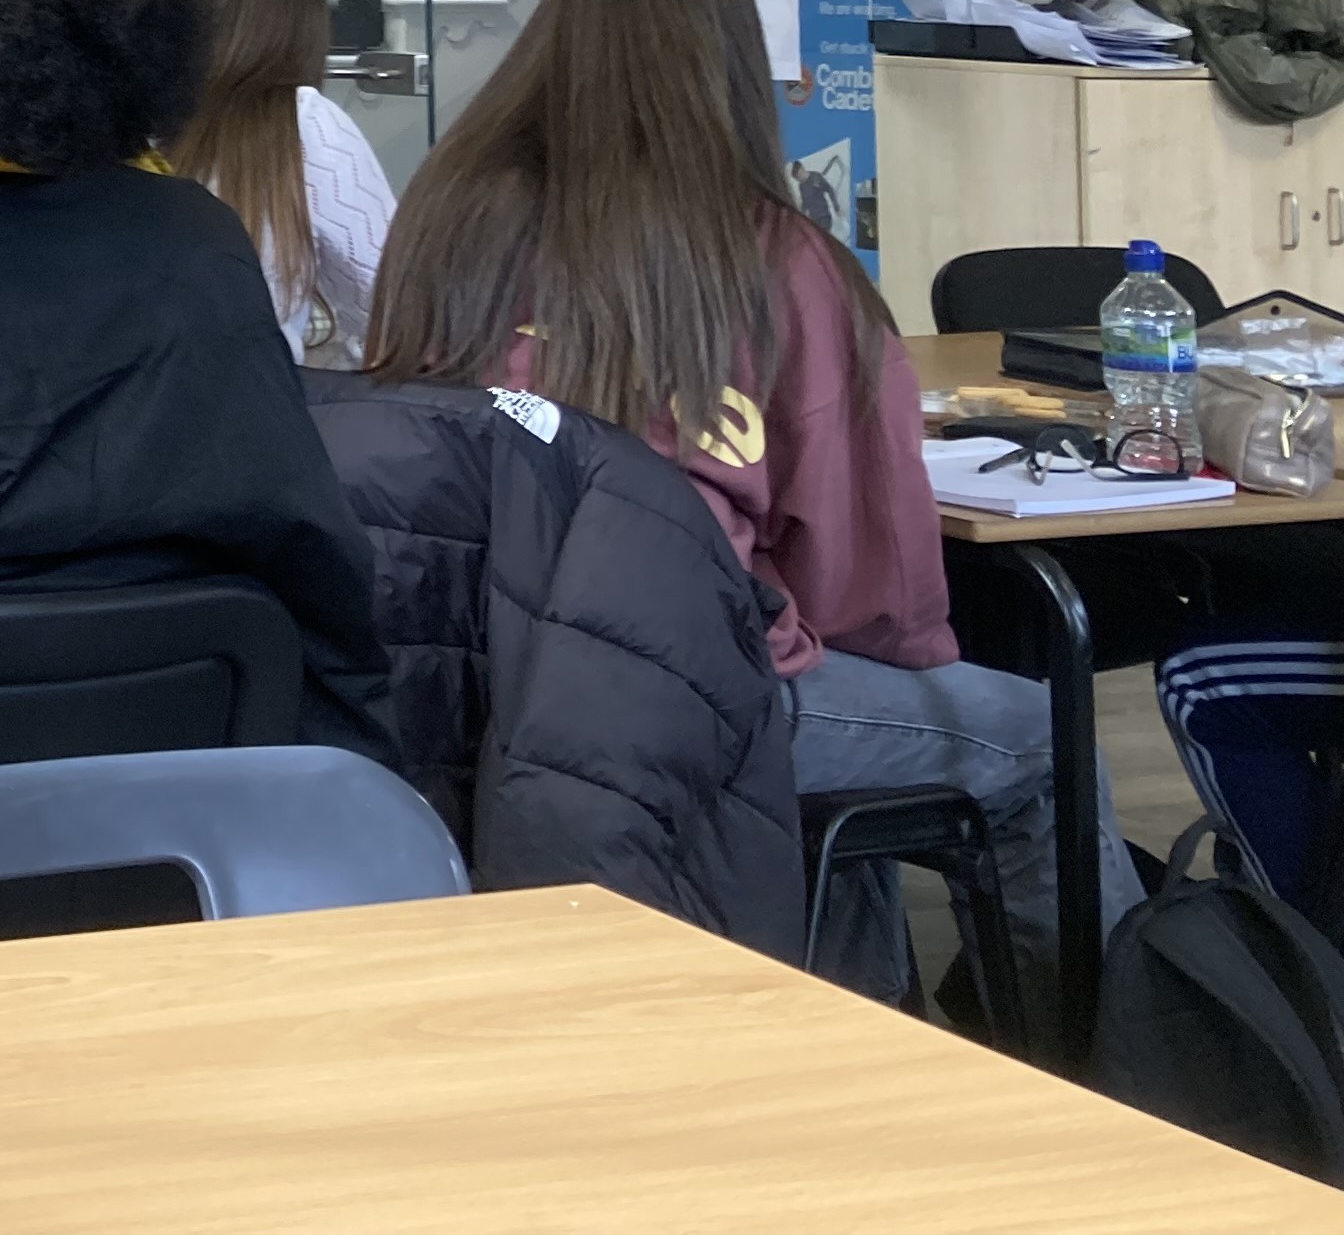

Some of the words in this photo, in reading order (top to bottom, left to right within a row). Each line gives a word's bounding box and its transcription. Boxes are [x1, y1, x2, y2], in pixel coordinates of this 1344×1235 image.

[486, 386, 535, 414] NORTH
[520, 388, 546, 406] THE
[492, 400, 531, 426] FACE
